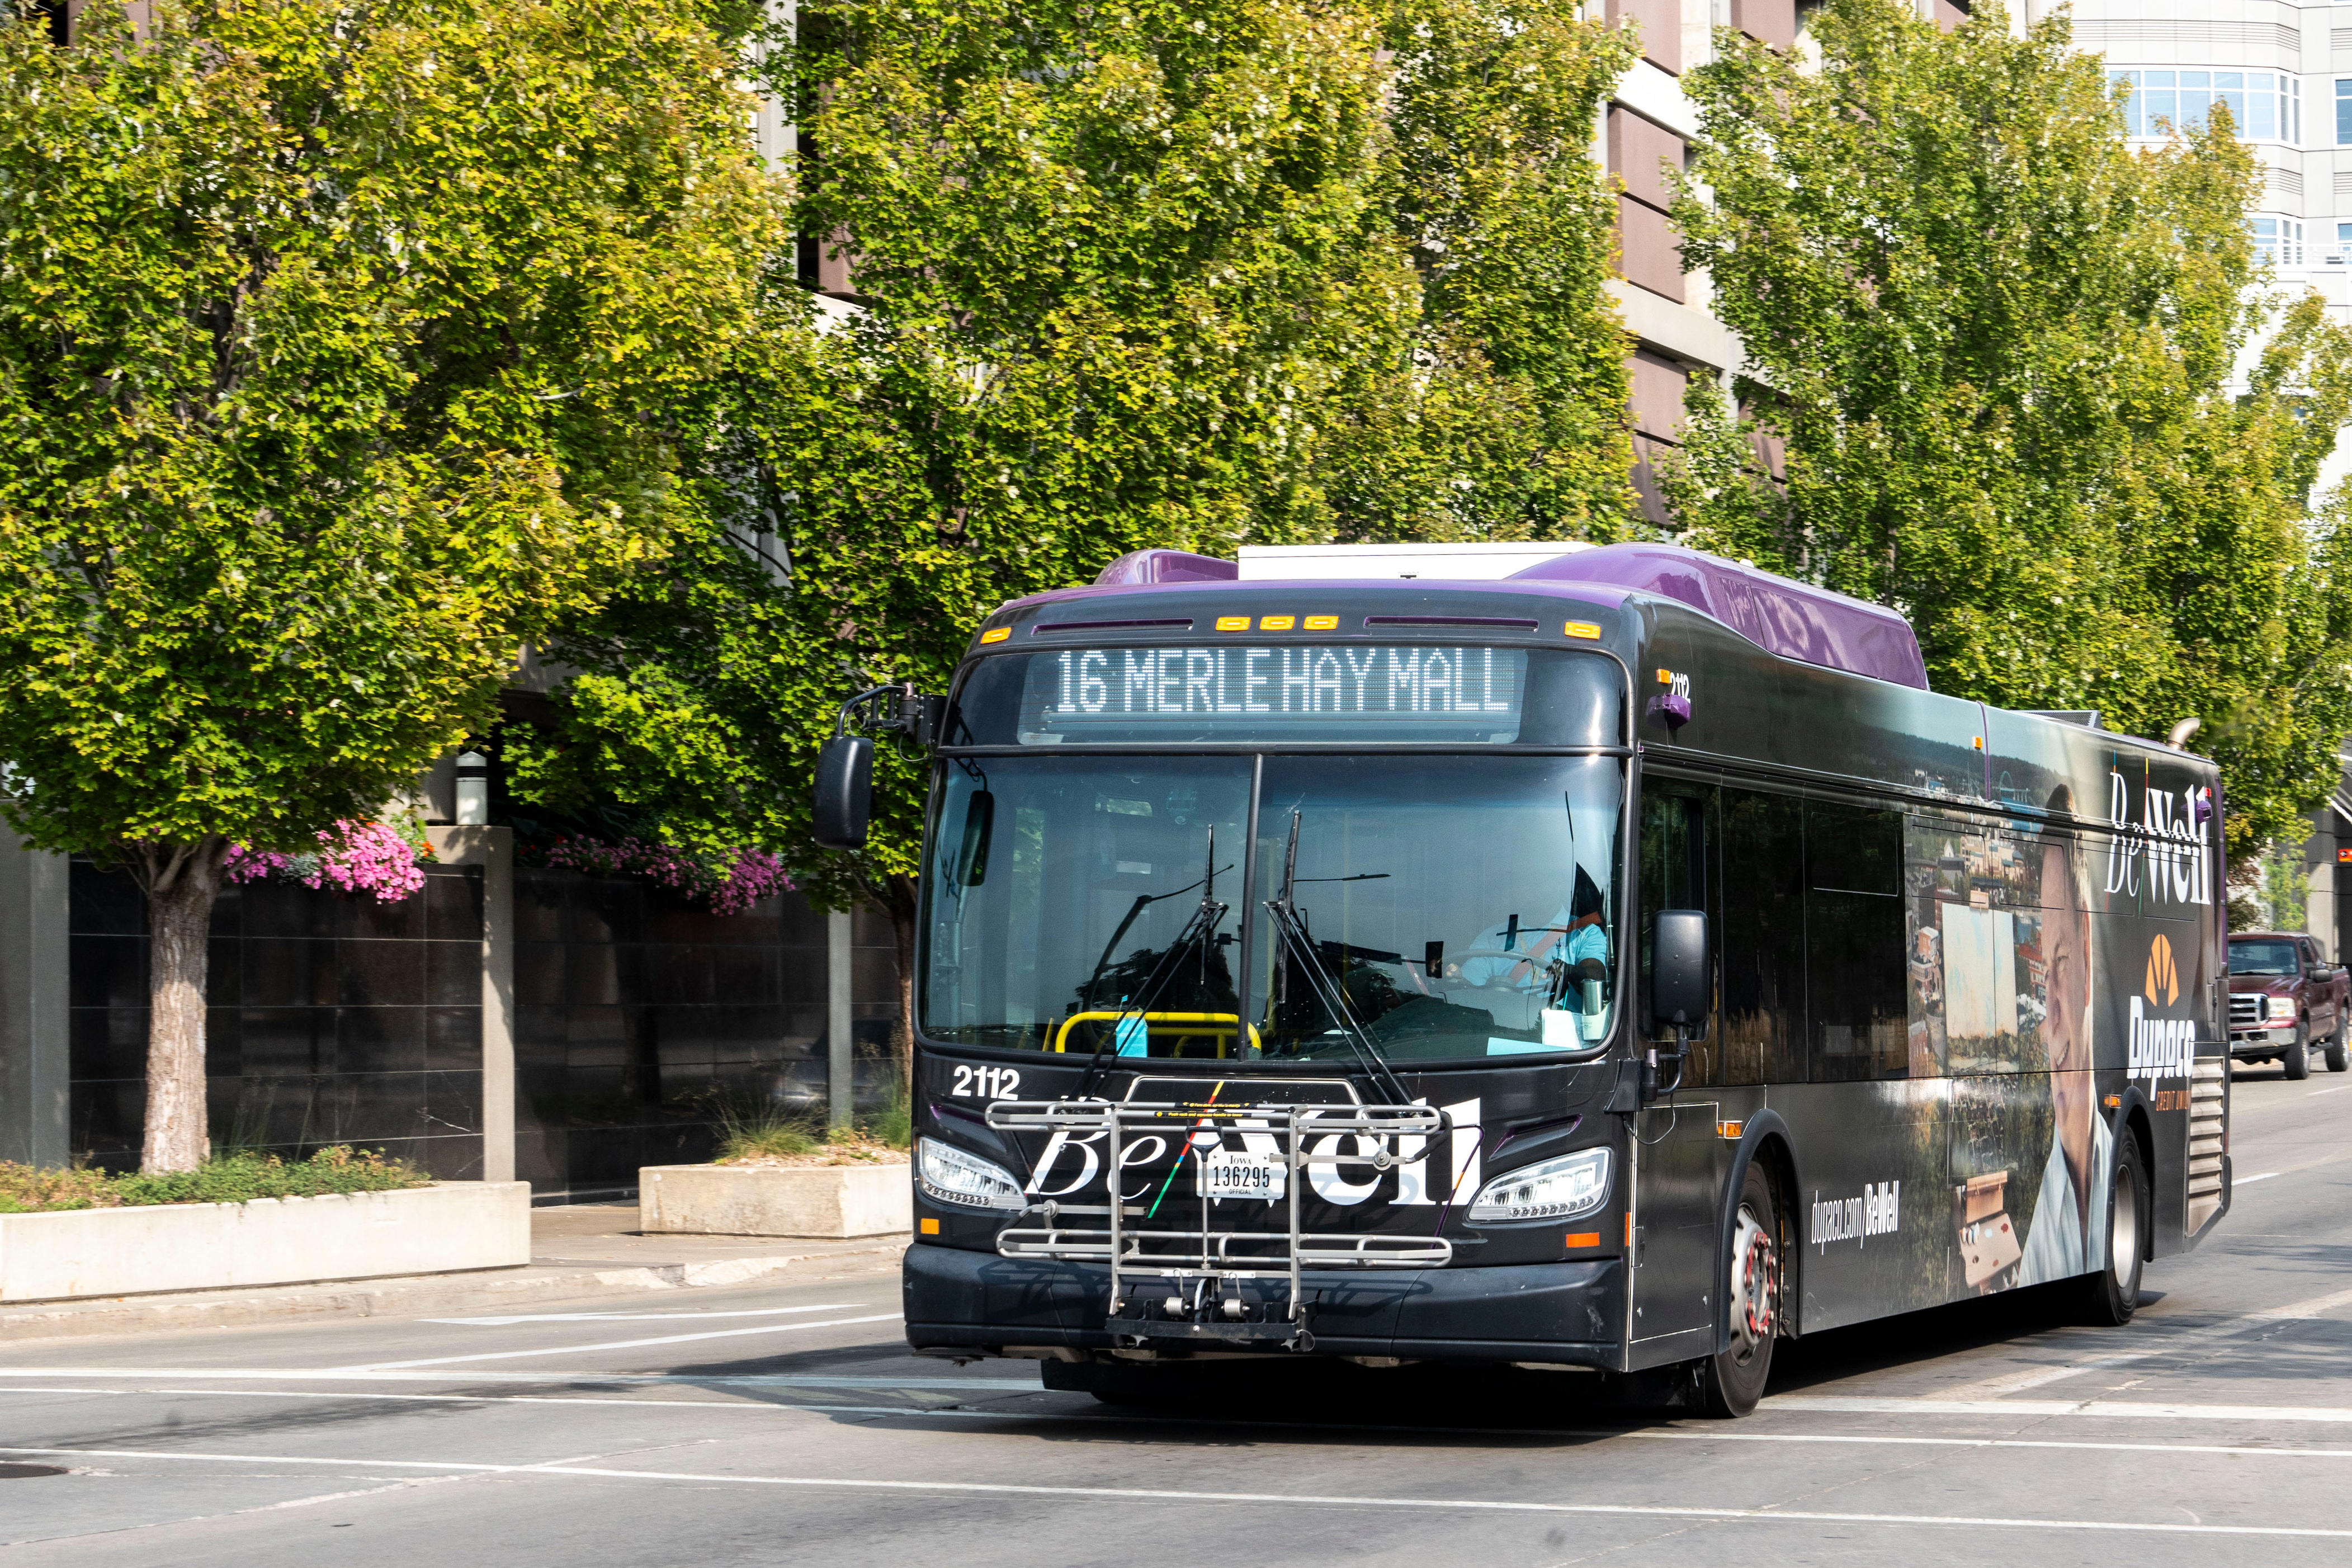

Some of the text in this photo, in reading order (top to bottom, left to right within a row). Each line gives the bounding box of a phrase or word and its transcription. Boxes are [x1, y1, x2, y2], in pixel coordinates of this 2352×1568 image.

[1058, 647, 1508, 712] 16 MERLE HAY MALL
[1670, 672, 1691, 703] 2112
[2144, 784, 2211, 905] Well
[2127, 995, 2195, 1101] Dupaco
[952, 1065, 1021, 1101] 2112
[1213, 1166, 1270, 1188] 136295
[1811, 1180, 1900, 1255] dupaco.com/BeWell
